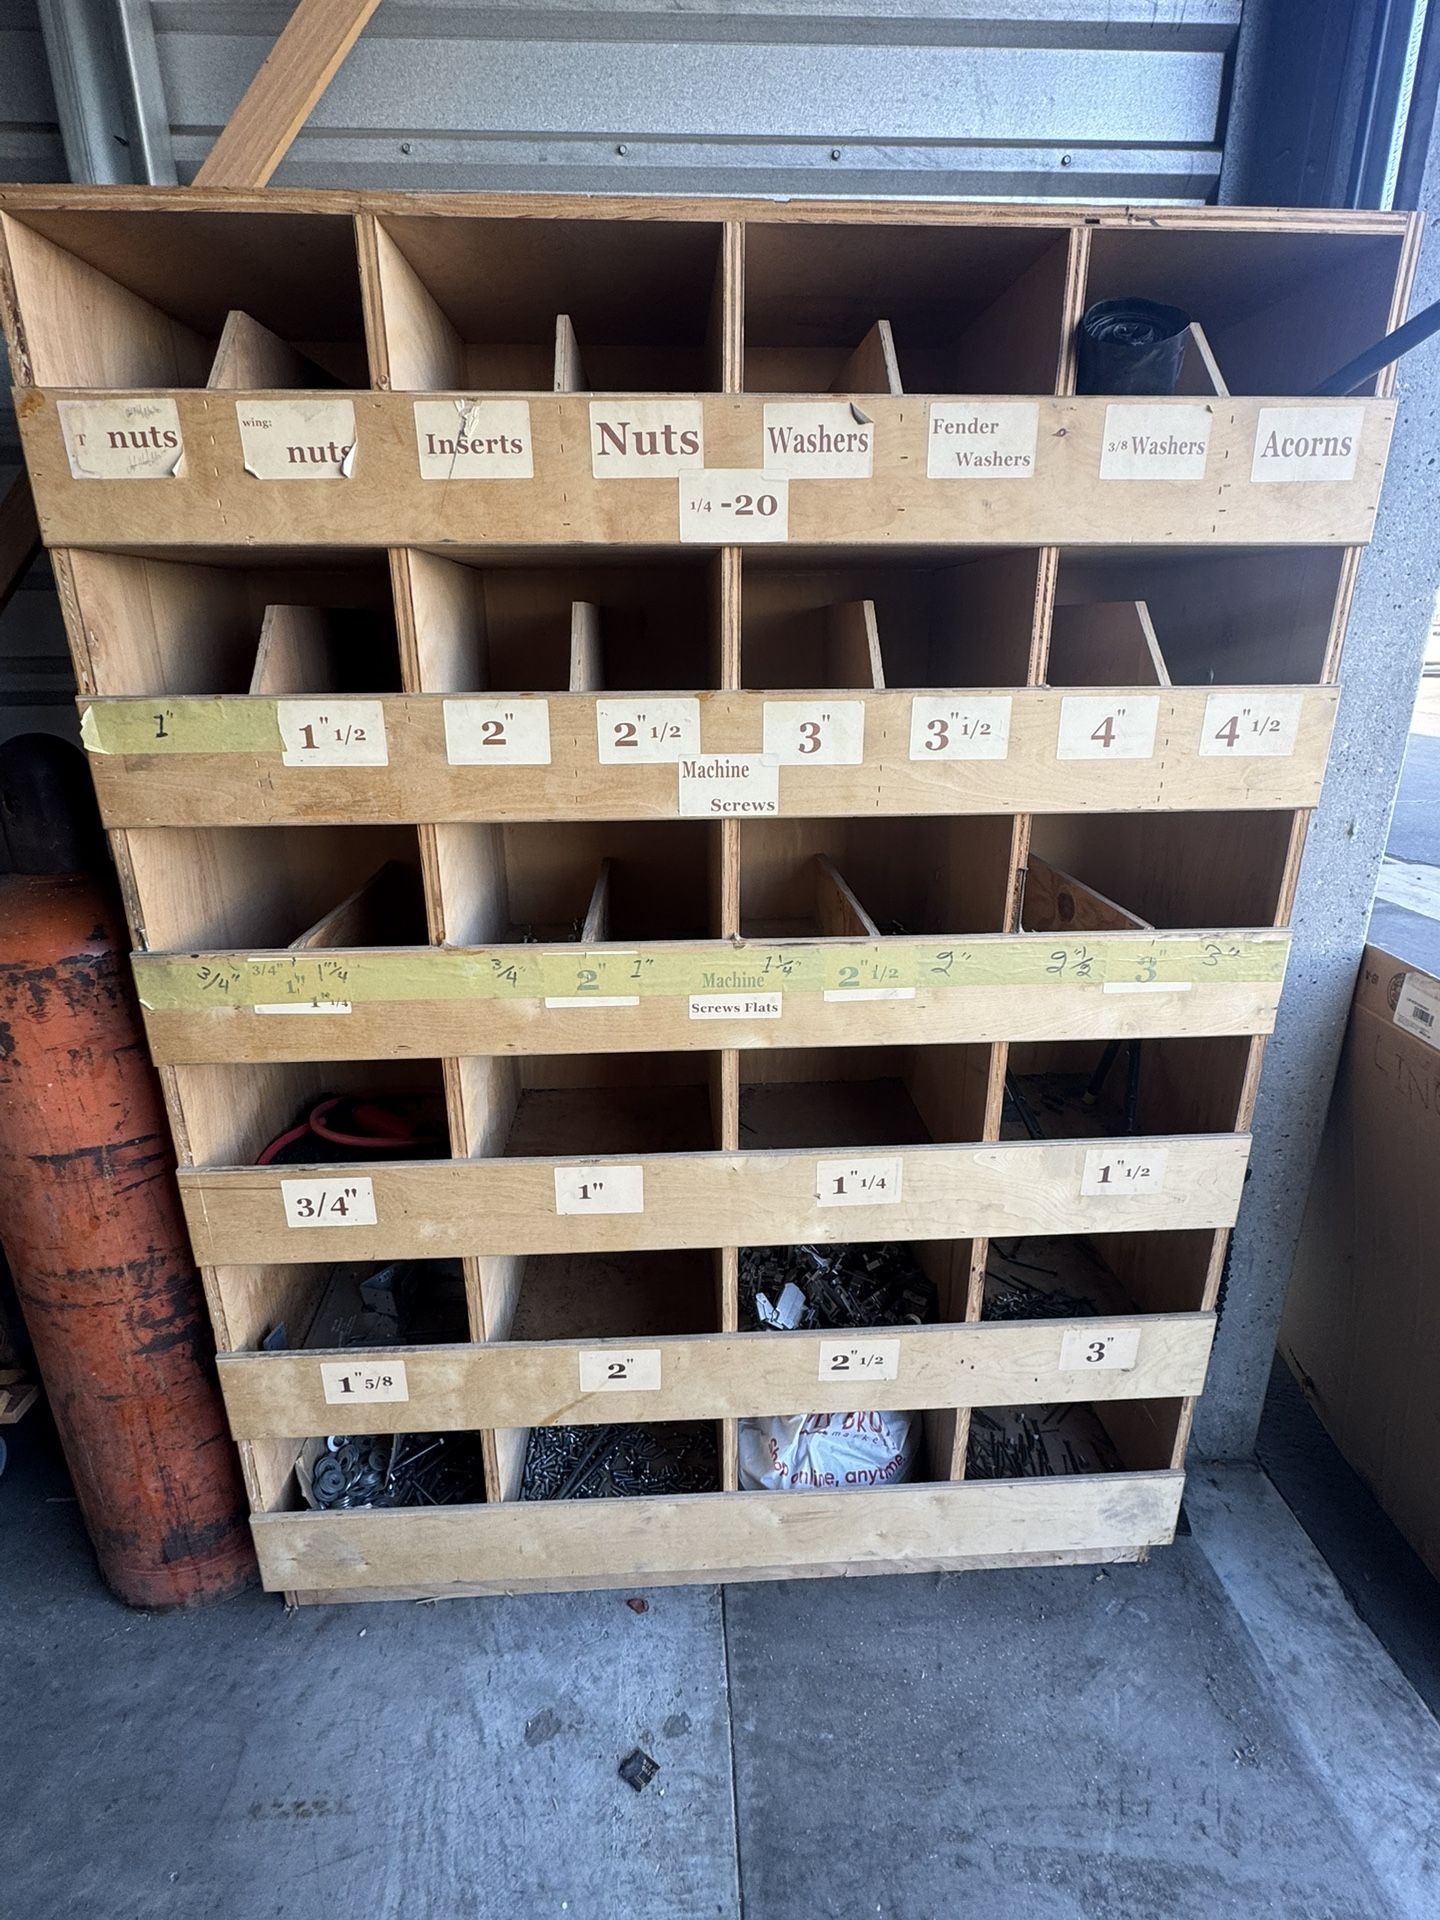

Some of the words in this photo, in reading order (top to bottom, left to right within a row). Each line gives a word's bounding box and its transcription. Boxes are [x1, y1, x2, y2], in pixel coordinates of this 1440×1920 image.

[242, 418, 272, 429] wing:
[933, 417, 999, 435] Fender
[76, 433, 86, 446] T
[107, 426, 178, 449] nuts
[425, 433, 524, 456] Inserts
[596, 422, 700, 455] Nuts
[767, 424, 869, 455] Washers
[1108, 440, 1128, 452] 3/8
[1132, 435, 1206, 456] Washers
[1260, 430, 1352, 459] Acorns
[955, 450, 1031, 467] Washers
[690, 498, 712, 513] 1/4
[720, 494, 778, 516] -20
[153, 710, 174, 738] 1"
[481, 713, 515, 747] 2"
[798, 714, 832, 754] 3"
[1090, 708, 1126, 748] 4"
[682, 759, 750, 779] Machine
[710, 798, 775, 812] Screws
[576, 963, 606, 991] 2"
[702, 971, 765, 989] Machine
[691, 1003, 741, 1014] Screws
[744, 1001, 779, 1013] Flats
[578, 1182, 604, 1200] 1"
[296, 1188, 358, 1218] 3/4"
[1086, 1337, 1115, 1363] 3"
[607, 1358, 634, 1380] 2"
